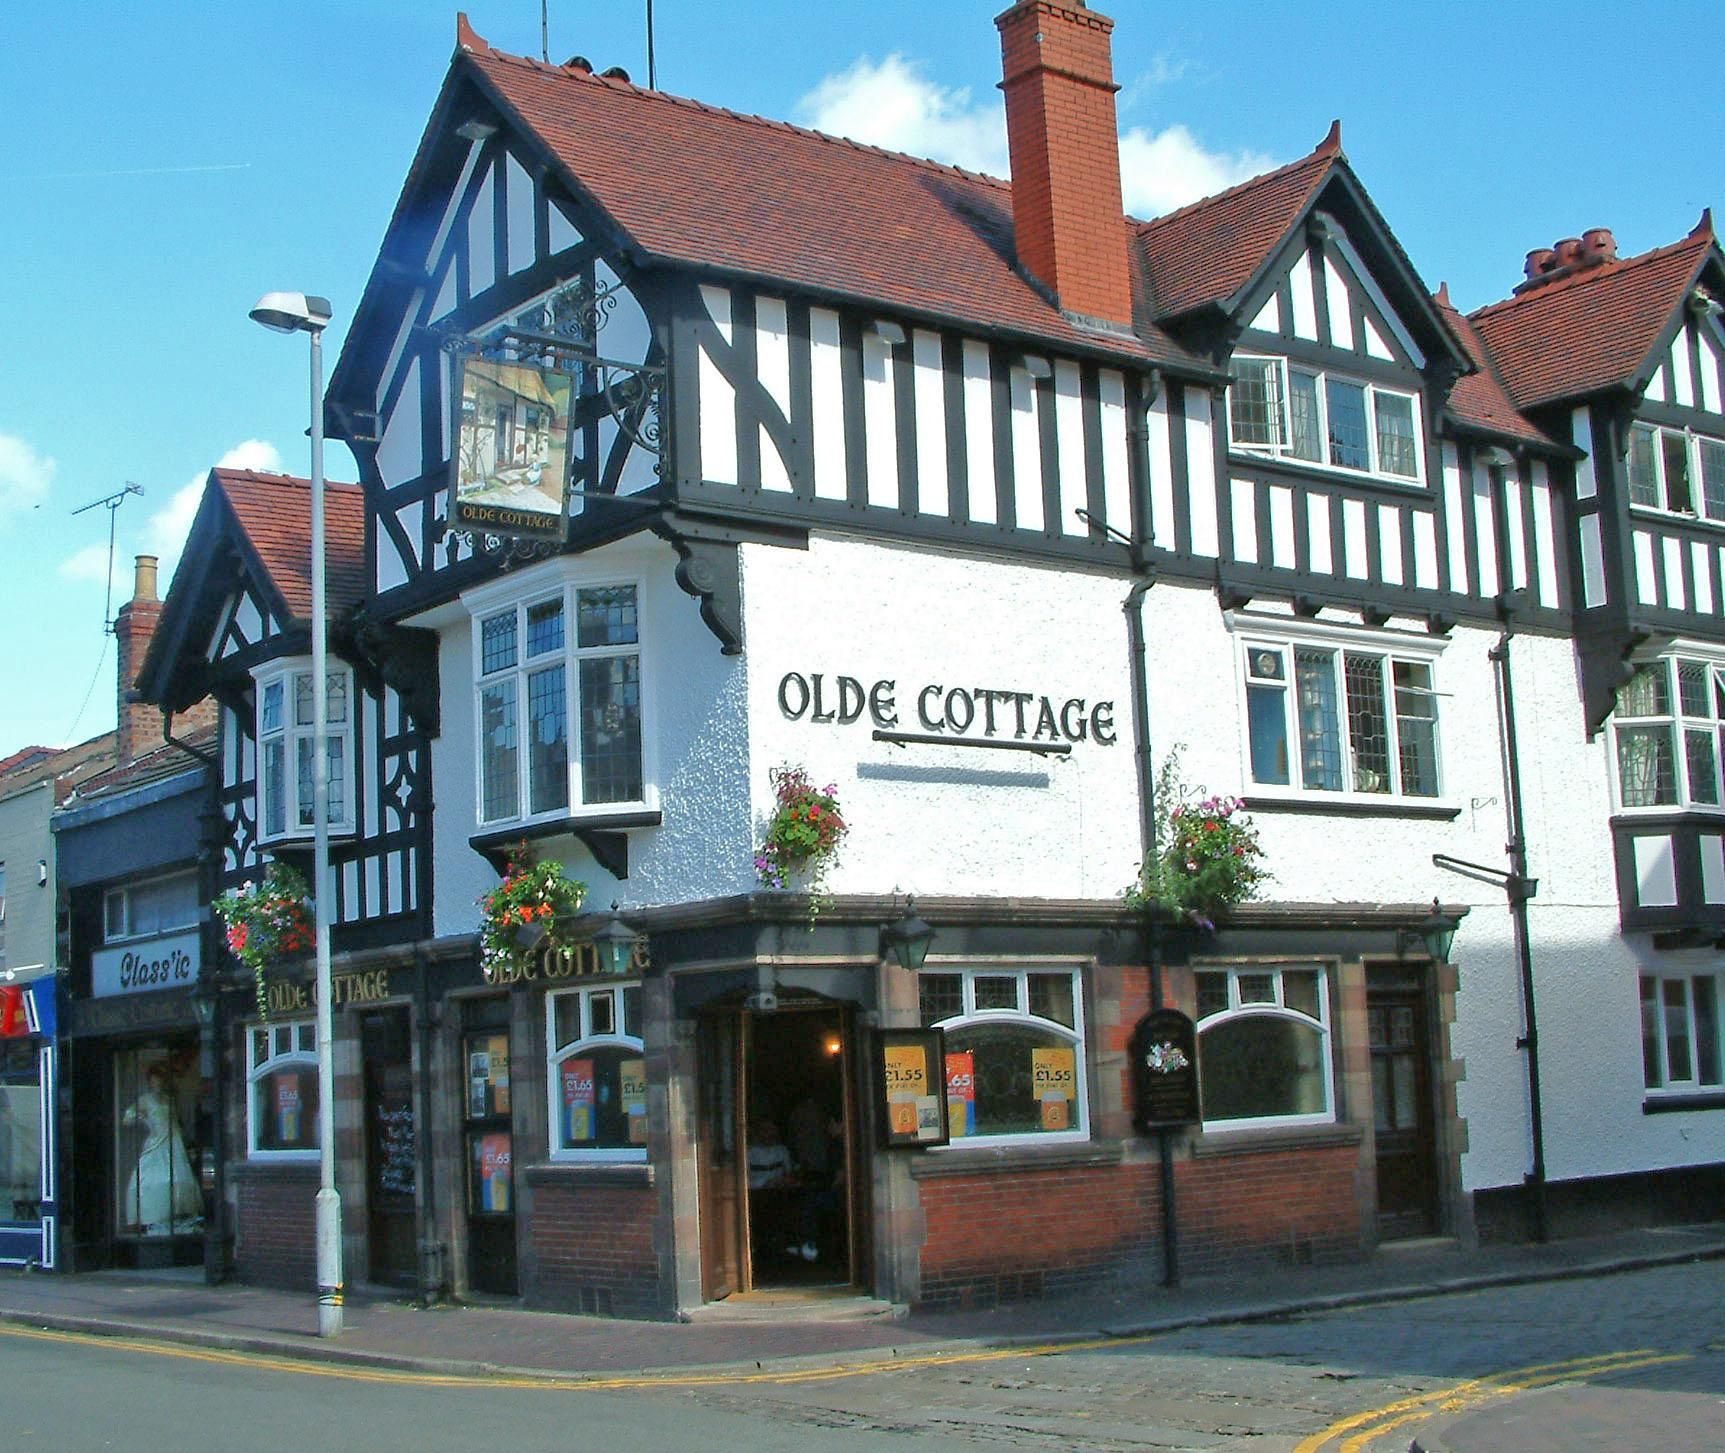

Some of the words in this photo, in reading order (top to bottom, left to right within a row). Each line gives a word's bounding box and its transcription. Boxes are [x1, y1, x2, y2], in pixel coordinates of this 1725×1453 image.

[463, 506, 496, 520] OLDE
[501, 512, 552, 528] COTTAGE
[777, 671, 899, 728] OLDE
[917, 684, 1117, 745] COTTAGE
[120, 949, 190, 988] Class'ic
[543, 942, 650, 978] COTTE
[312, 970, 389, 1002] TTAGE
[566, 1080, 593, 1091] £1.65
[1036, 1070, 1071, 1081] £1.55
